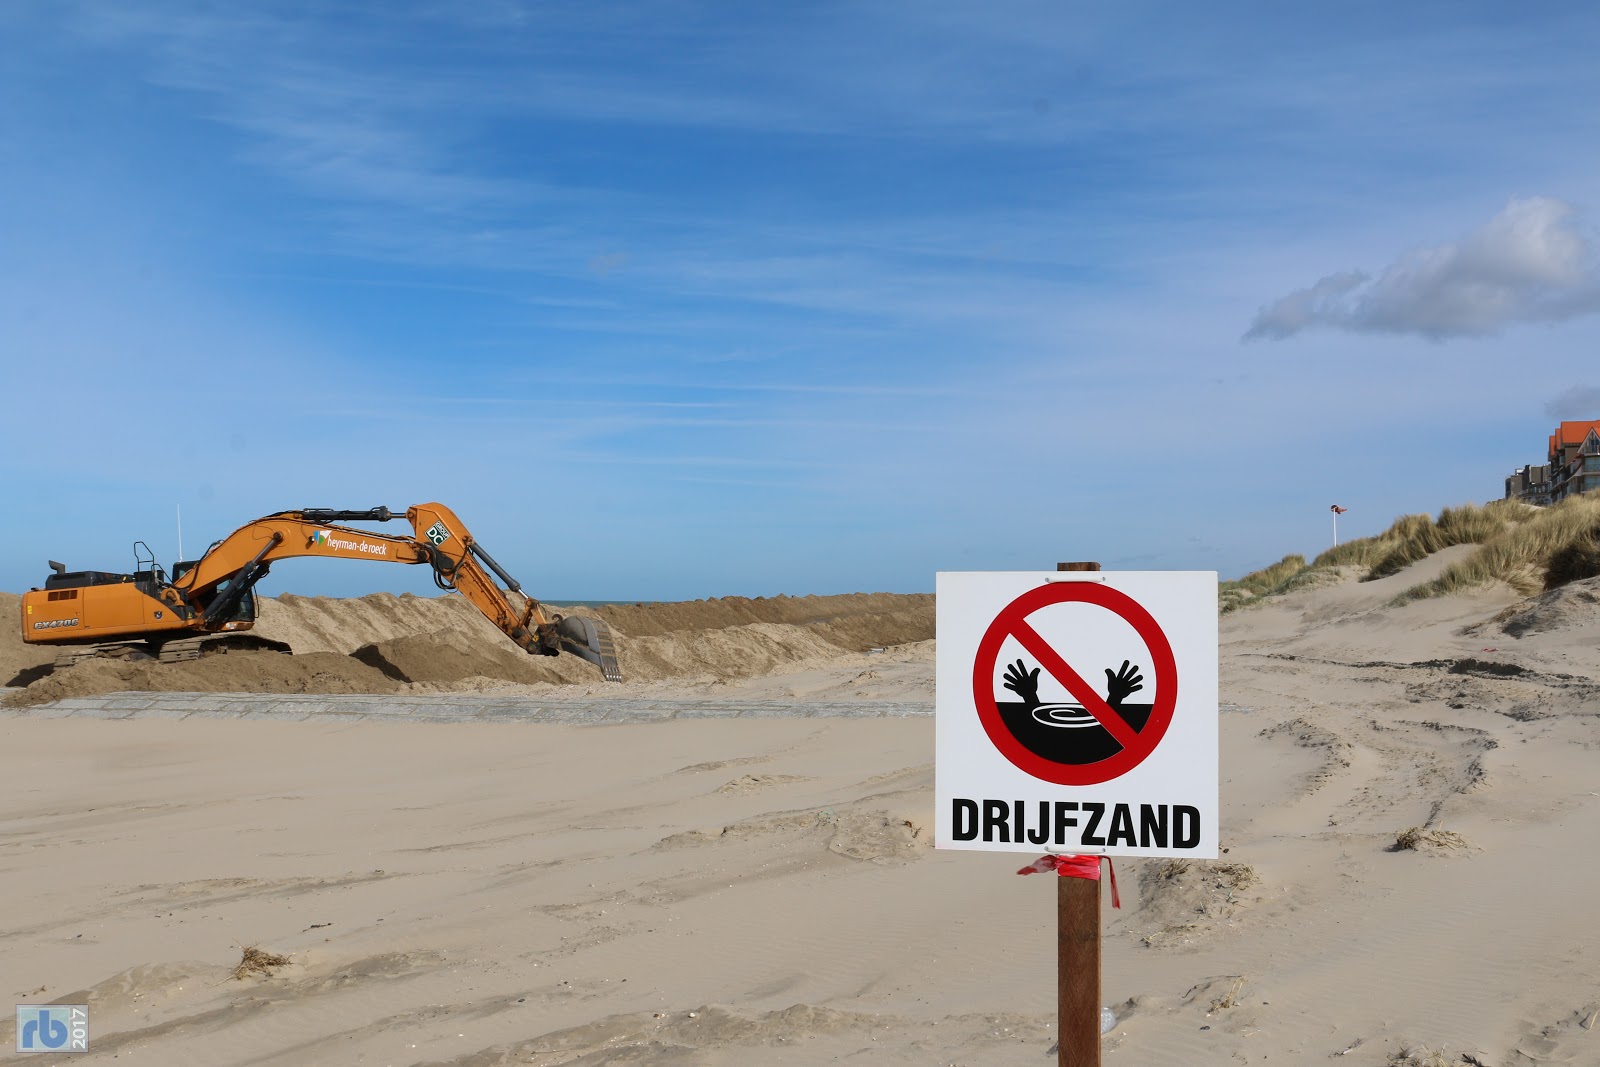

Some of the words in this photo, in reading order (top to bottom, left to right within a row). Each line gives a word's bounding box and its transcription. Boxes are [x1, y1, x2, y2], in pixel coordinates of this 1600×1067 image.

[426, 527, 444, 545] DC
[368, 544, 387, 555] roeck
[952, 798, 1201, 849] DRIJFZAND
